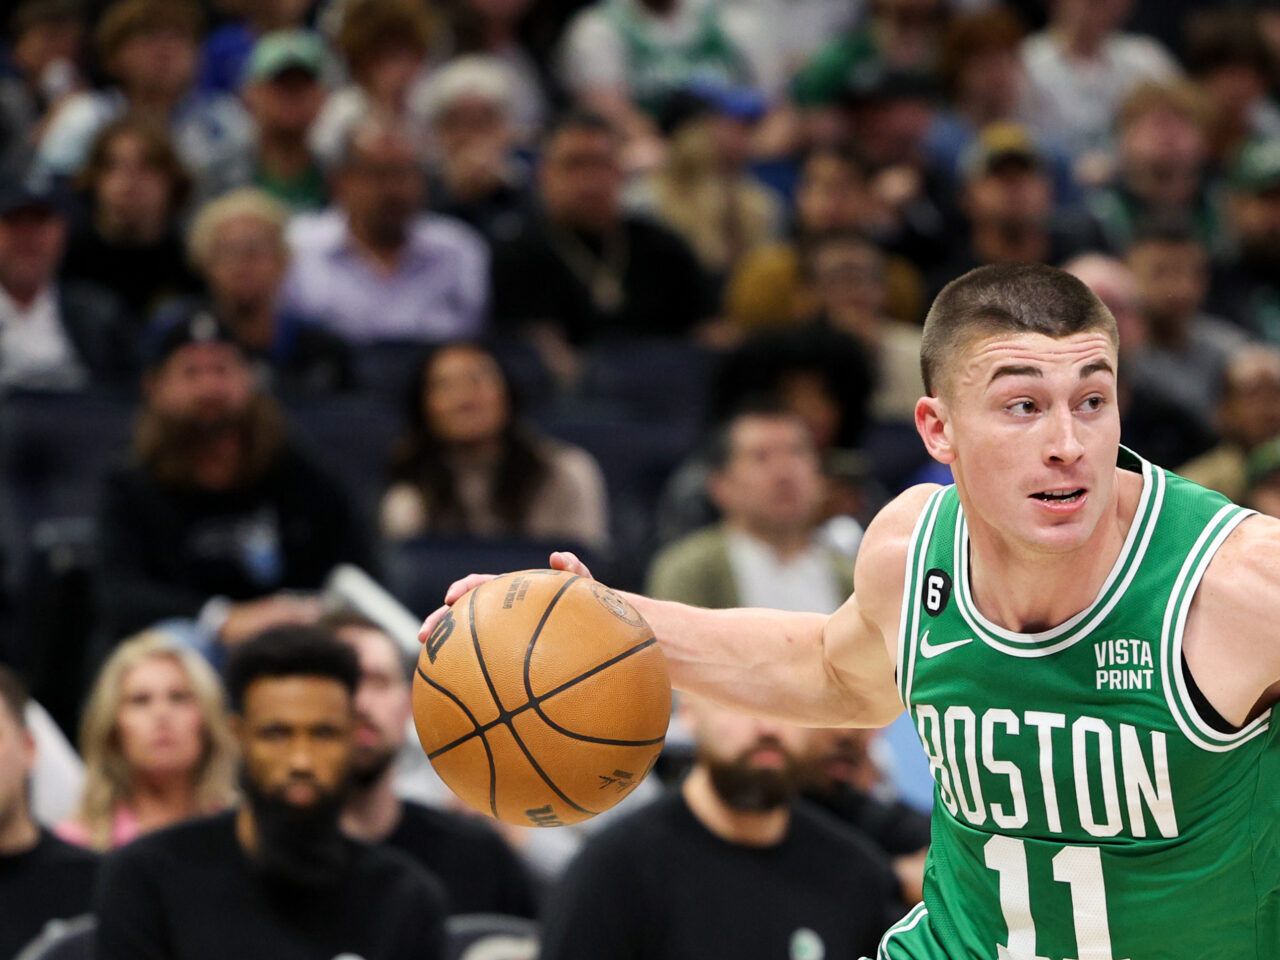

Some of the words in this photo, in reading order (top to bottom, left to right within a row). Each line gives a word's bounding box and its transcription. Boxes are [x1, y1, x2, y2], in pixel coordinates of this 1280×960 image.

[926, 574, 945, 612] 6
[1093, 638, 1154, 669] VISTA
[1095, 669, 1155, 691] PRINT
[915, 703, 1179, 839] BOSTON
